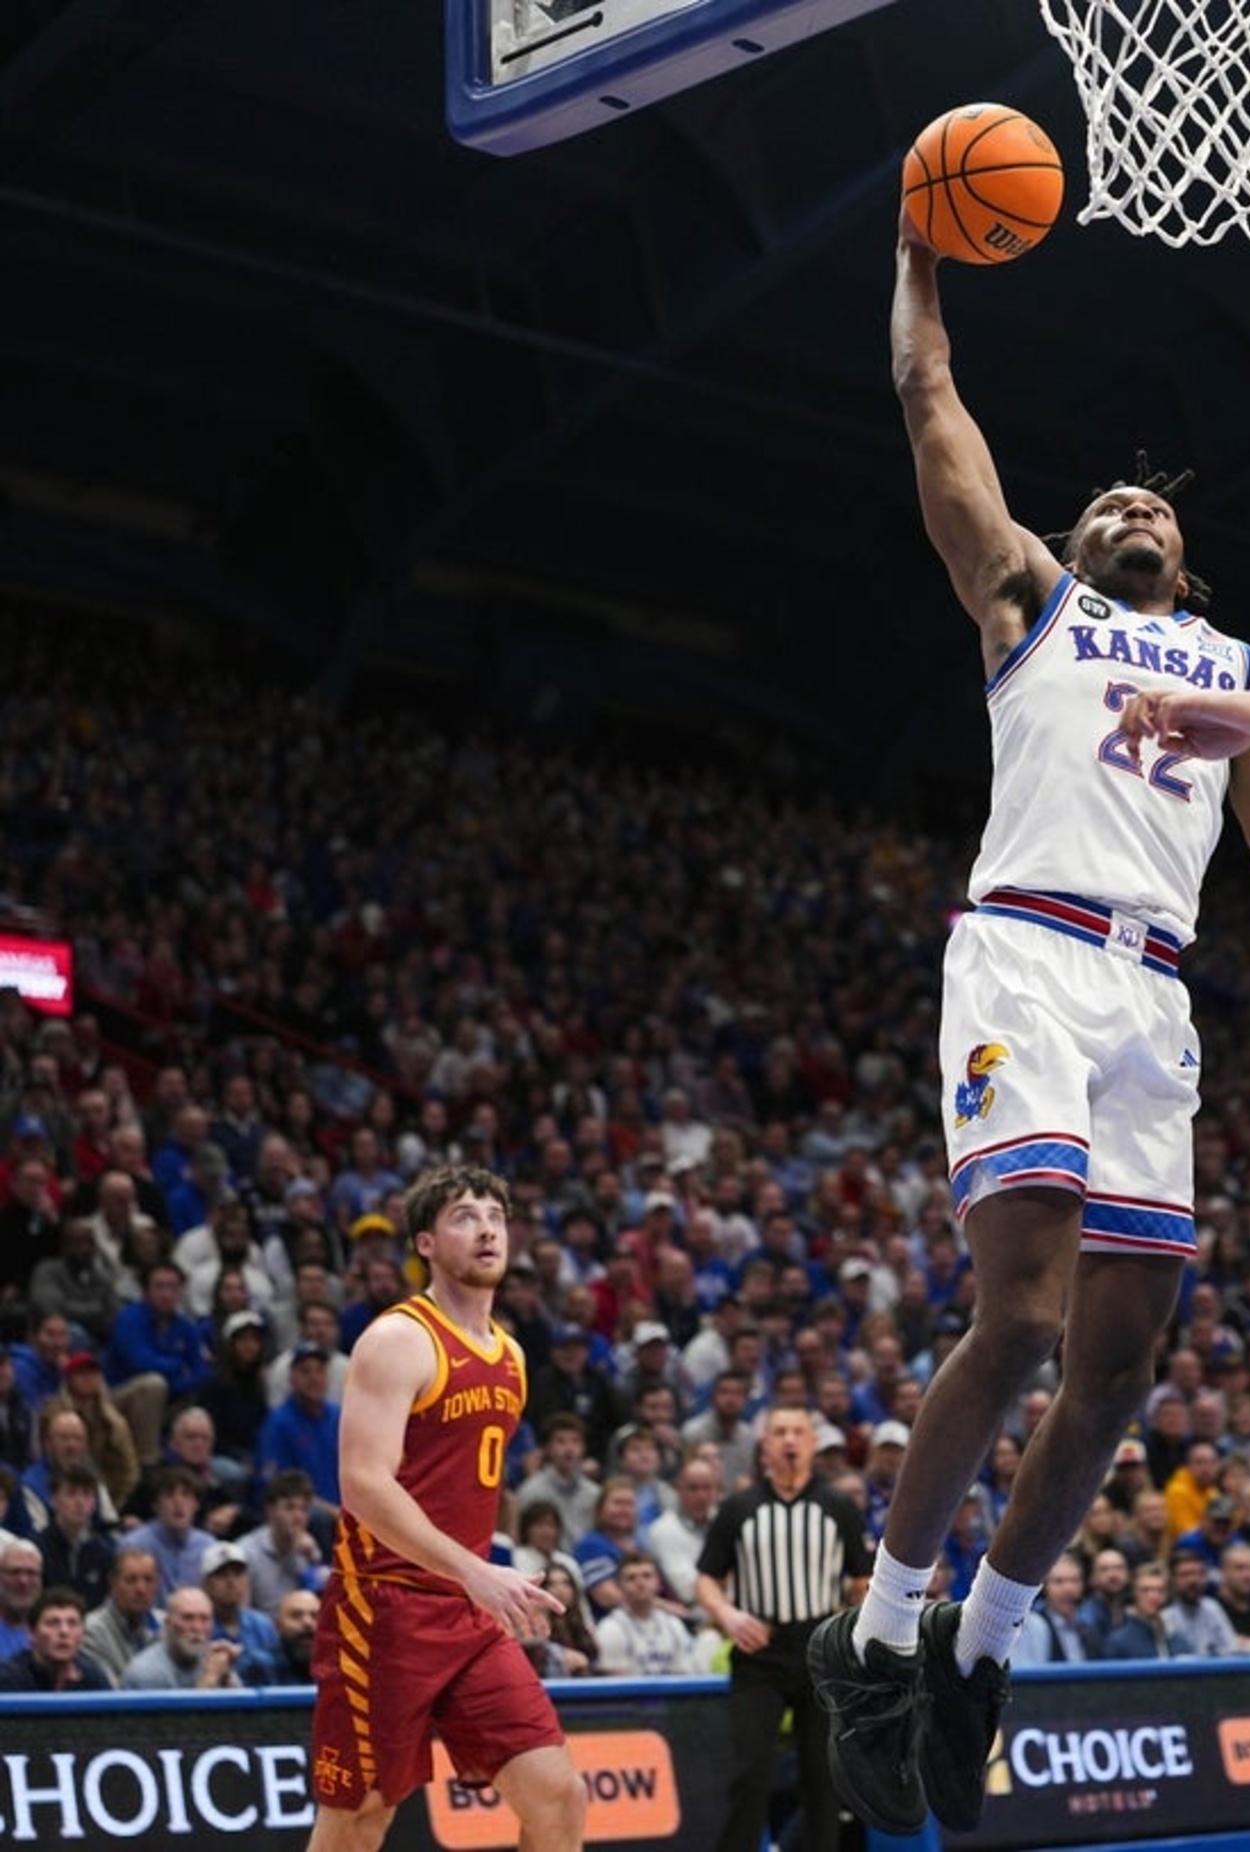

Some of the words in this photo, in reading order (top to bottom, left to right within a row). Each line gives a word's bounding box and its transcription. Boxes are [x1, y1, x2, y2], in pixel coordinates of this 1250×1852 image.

[1069, 625, 1236, 691] KANSAS
[441, 1385, 491, 1423] IOWA
[478, 1425, 504, 1488] 0
[1011, 1726, 1192, 1787] CHOICE
[0, 1745, 315, 1840] HOICE
